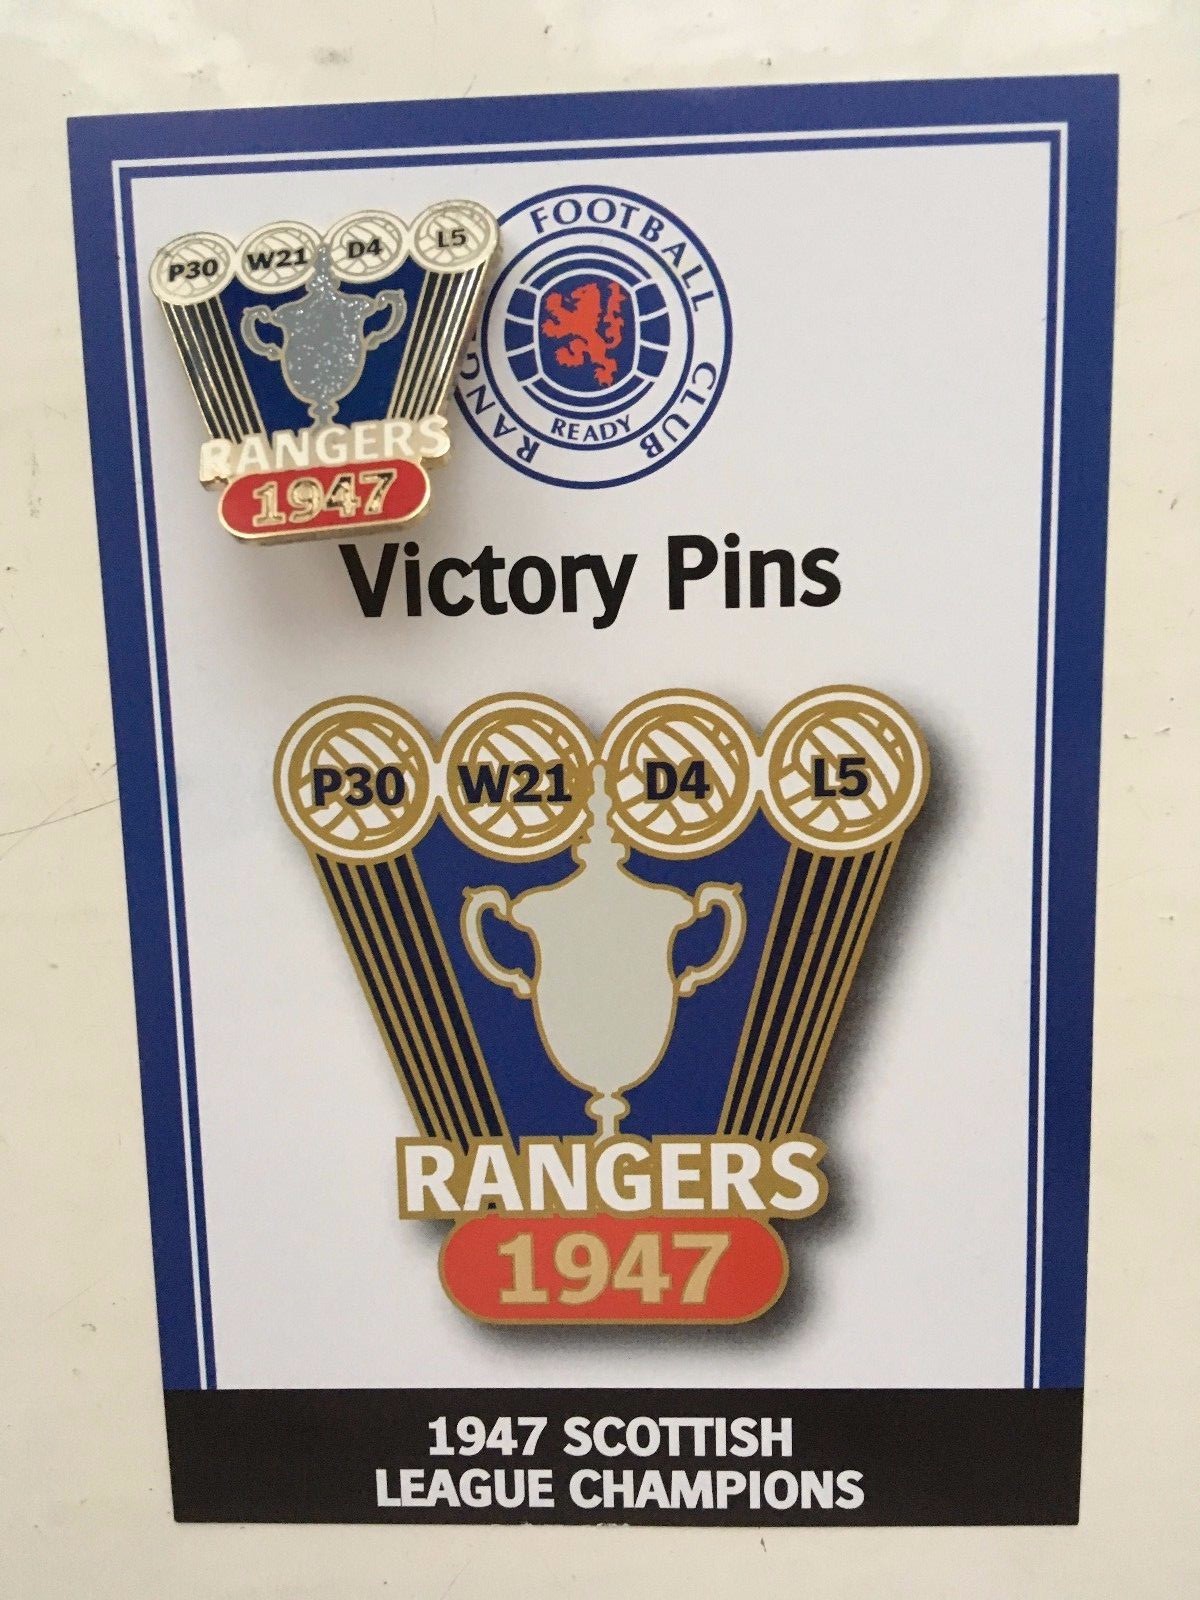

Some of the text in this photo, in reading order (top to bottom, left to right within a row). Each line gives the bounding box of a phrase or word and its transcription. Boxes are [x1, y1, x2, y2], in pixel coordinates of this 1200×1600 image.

[168, 228, 468, 282] P30 W21 D4 L5
[459, 198, 718, 463] RANG FOOTBALL CLUB
[200, 415, 450, 481] RANGERS
[550, 415, 635, 443] READY
[252, 468, 398, 527] 1947
[338, 532, 842, 629] Victory Pins
[312, 757, 869, 808] P30 W21 D4 L5
[404, 1140, 822, 1213] RANGERS
[498, 1231, 732, 1306] 1947
[428, 1416, 793, 1458] 1947 SCOTTISH
[375, 1468, 865, 1511] LEAGUE CHAMPIONS
